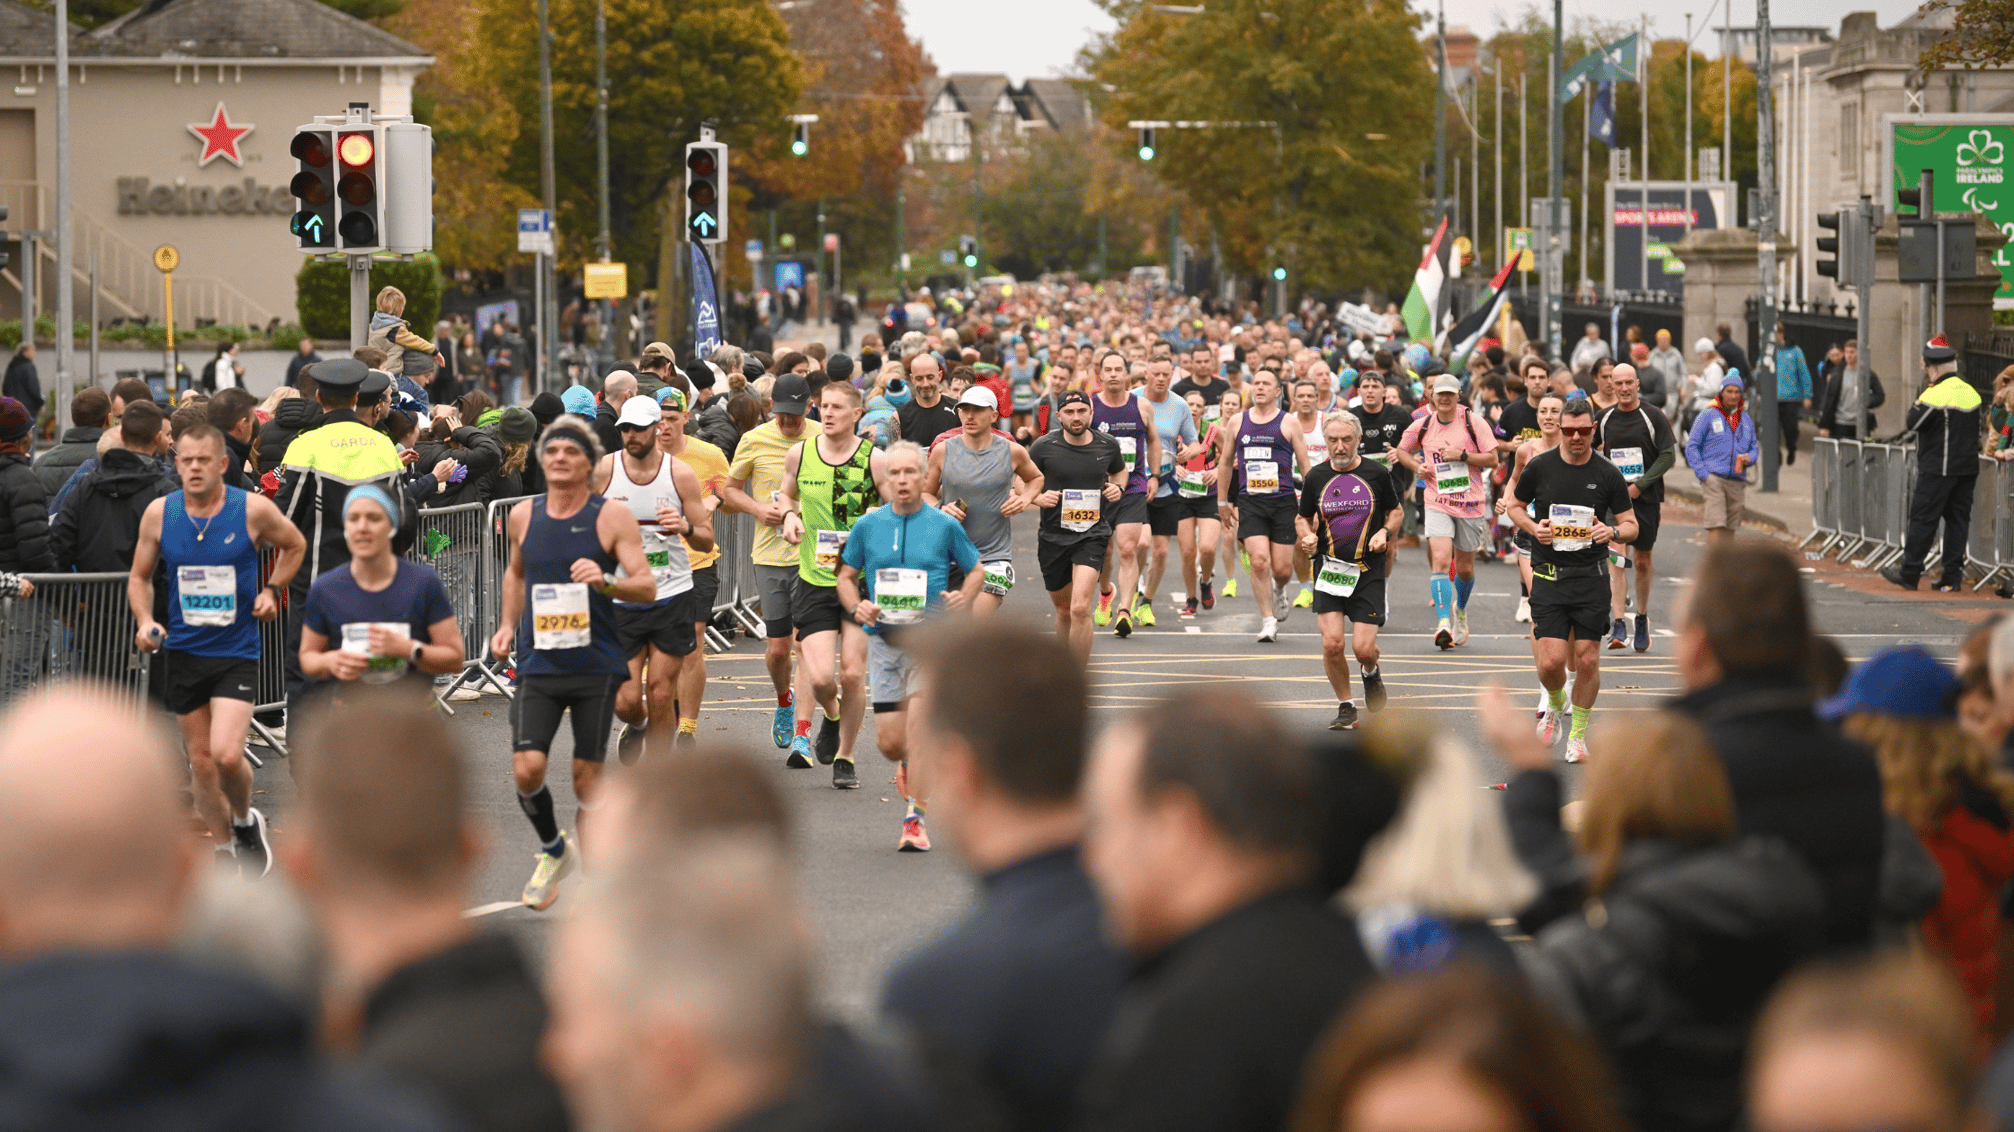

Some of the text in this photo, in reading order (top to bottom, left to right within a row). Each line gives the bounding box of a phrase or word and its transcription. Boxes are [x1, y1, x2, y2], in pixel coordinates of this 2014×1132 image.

[1957, 174, 2003, 184] IRELAND
[117, 176, 297, 215] Heineke
[1614, 212, 1655, 224] SPORS
[330, 437, 377, 448] GARDA
[1251, 479, 1274, 488] 3550
[1324, 500, 1369, 508] WEXFORD
[1068, 510, 1095, 520] 1632
[1554, 527, 1587, 538] 2865
[1322, 571, 1356, 586] 10680
[185, 596, 231, 610] 12201
[881, 595, 919, 608] 9440
[540, 615, 579, 630] 2976
